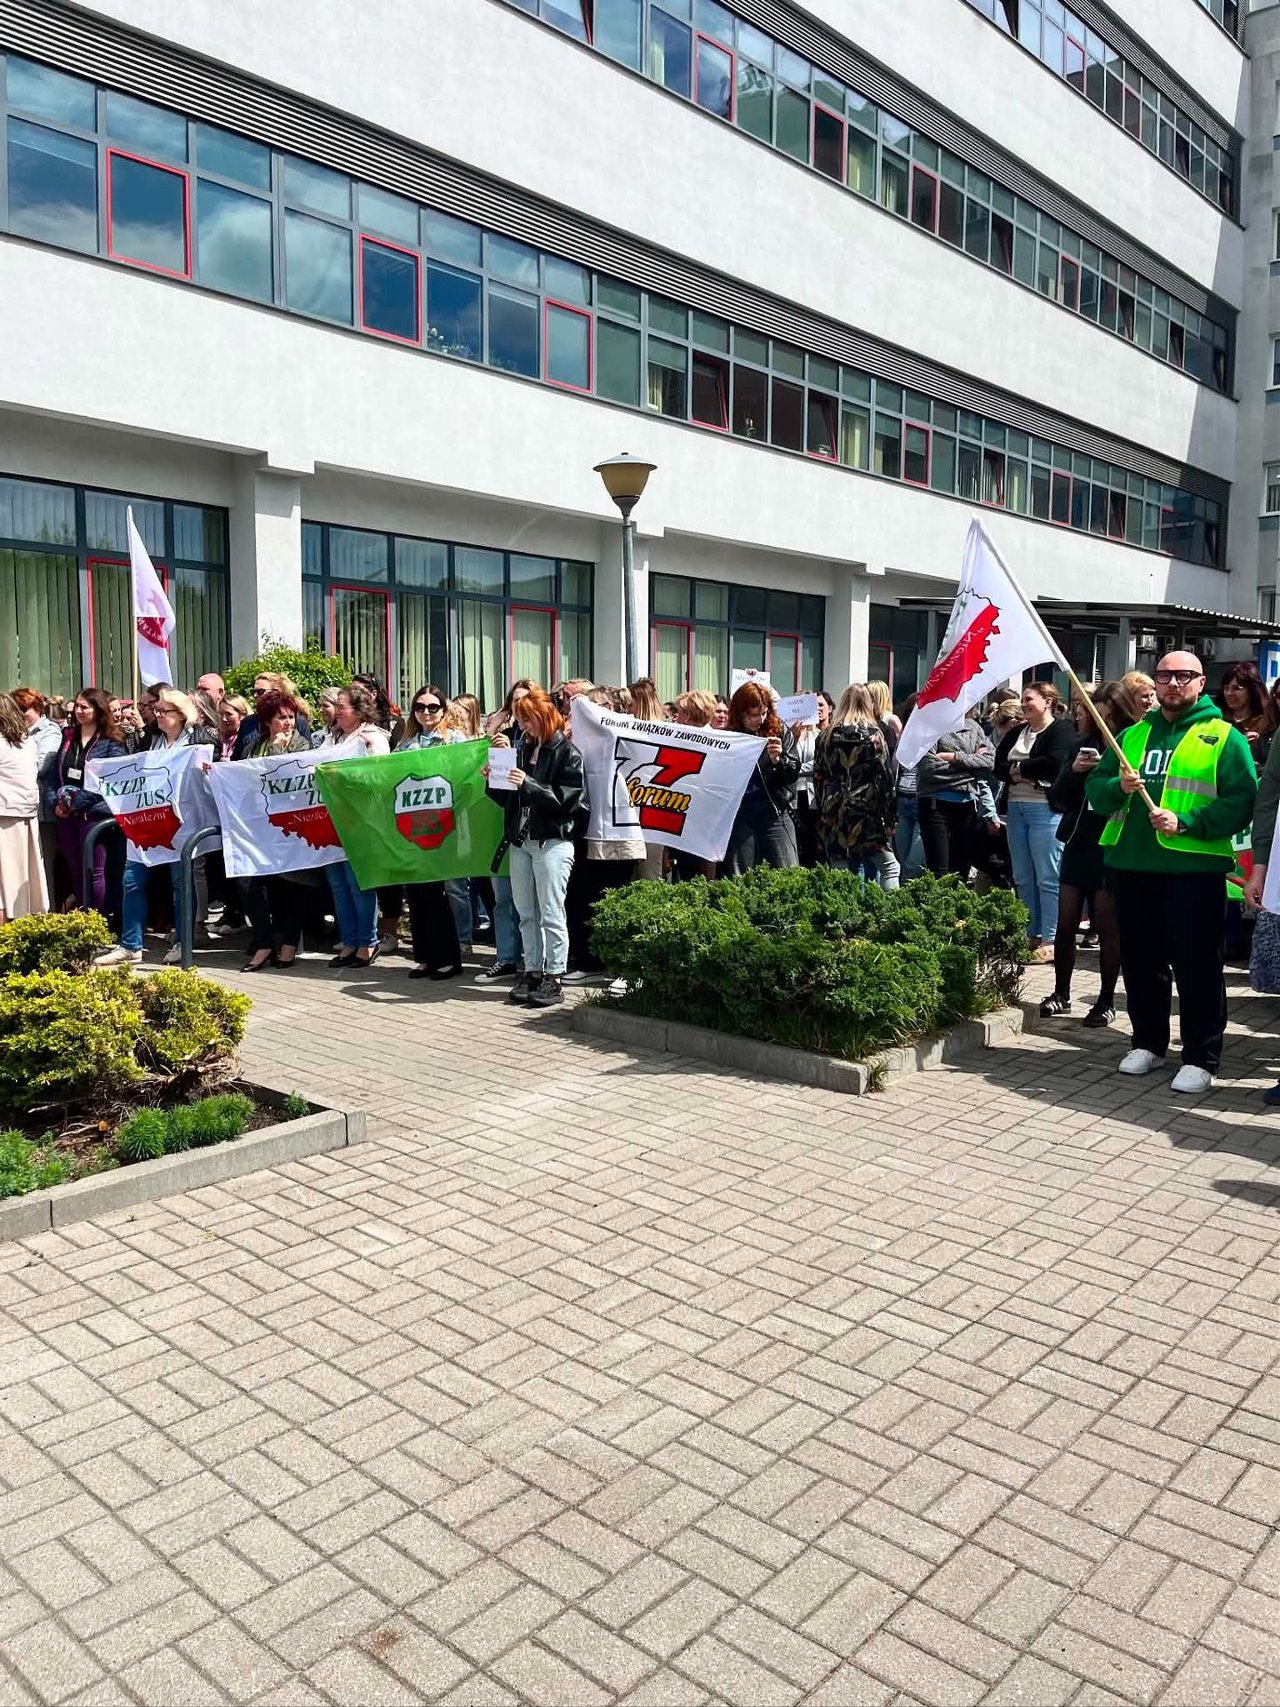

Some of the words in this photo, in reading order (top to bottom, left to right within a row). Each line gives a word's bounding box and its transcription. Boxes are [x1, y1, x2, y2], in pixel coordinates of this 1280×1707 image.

[631, 721, 674, 736] ZWIĄZKÓW
[674, 730, 731, 751] ZAWODOWYCH
[104, 776, 146, 797] KZZP
[268, 772, 315, 795] KZZP
[626, 777, 692, 812] forum
[135, 789, 165, 809] ZUS
[402, 787, 447, 808] KZZP
